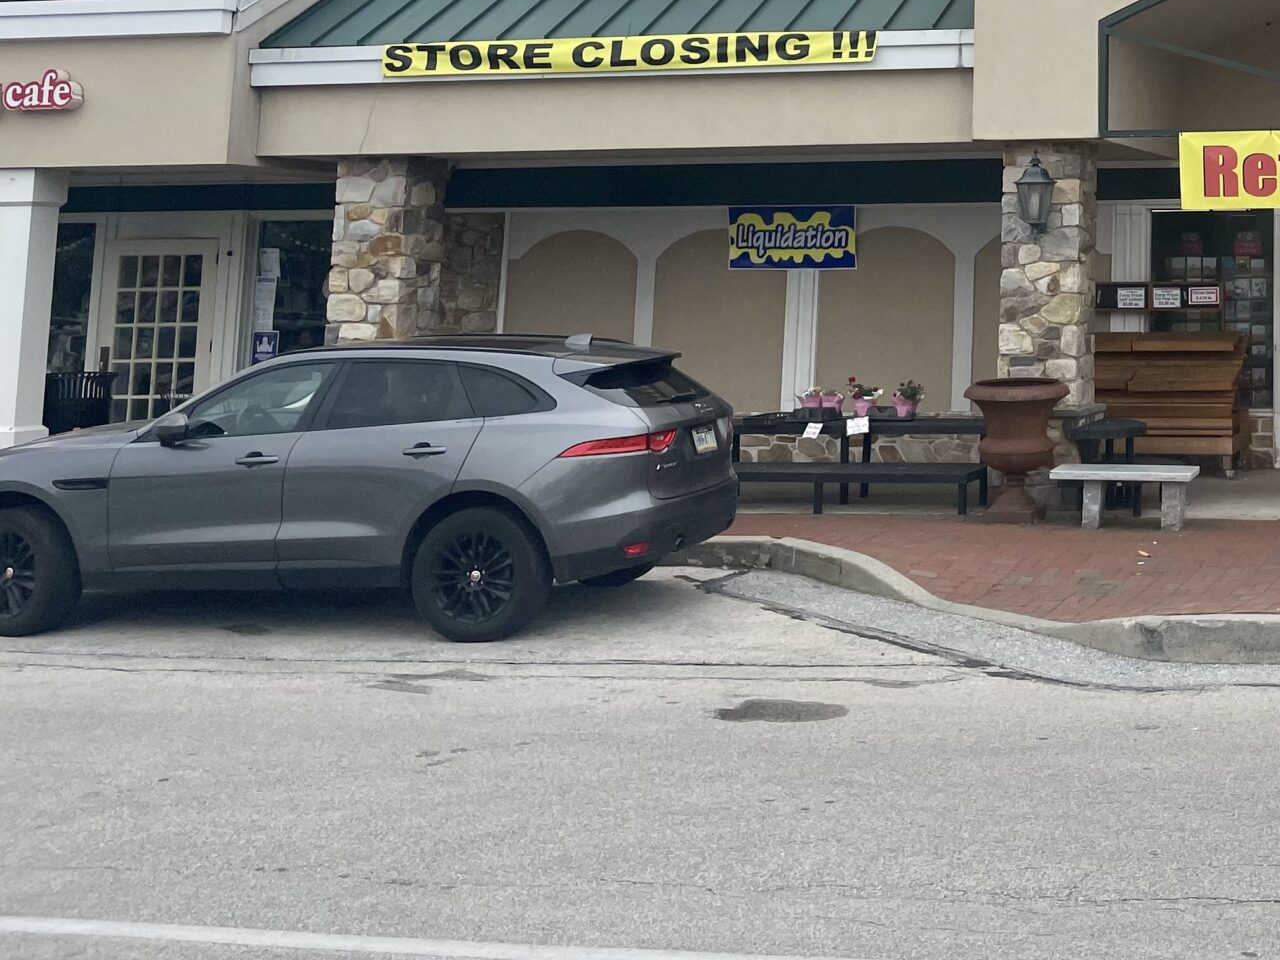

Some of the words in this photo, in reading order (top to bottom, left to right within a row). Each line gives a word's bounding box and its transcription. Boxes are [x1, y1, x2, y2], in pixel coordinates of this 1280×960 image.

[384, 43, 553, 72] STORE
[571, 33, 811, 68] CLOSING
[5, 70, 71, 108] cafe
[737, 224, 848, 257] Liquidation
